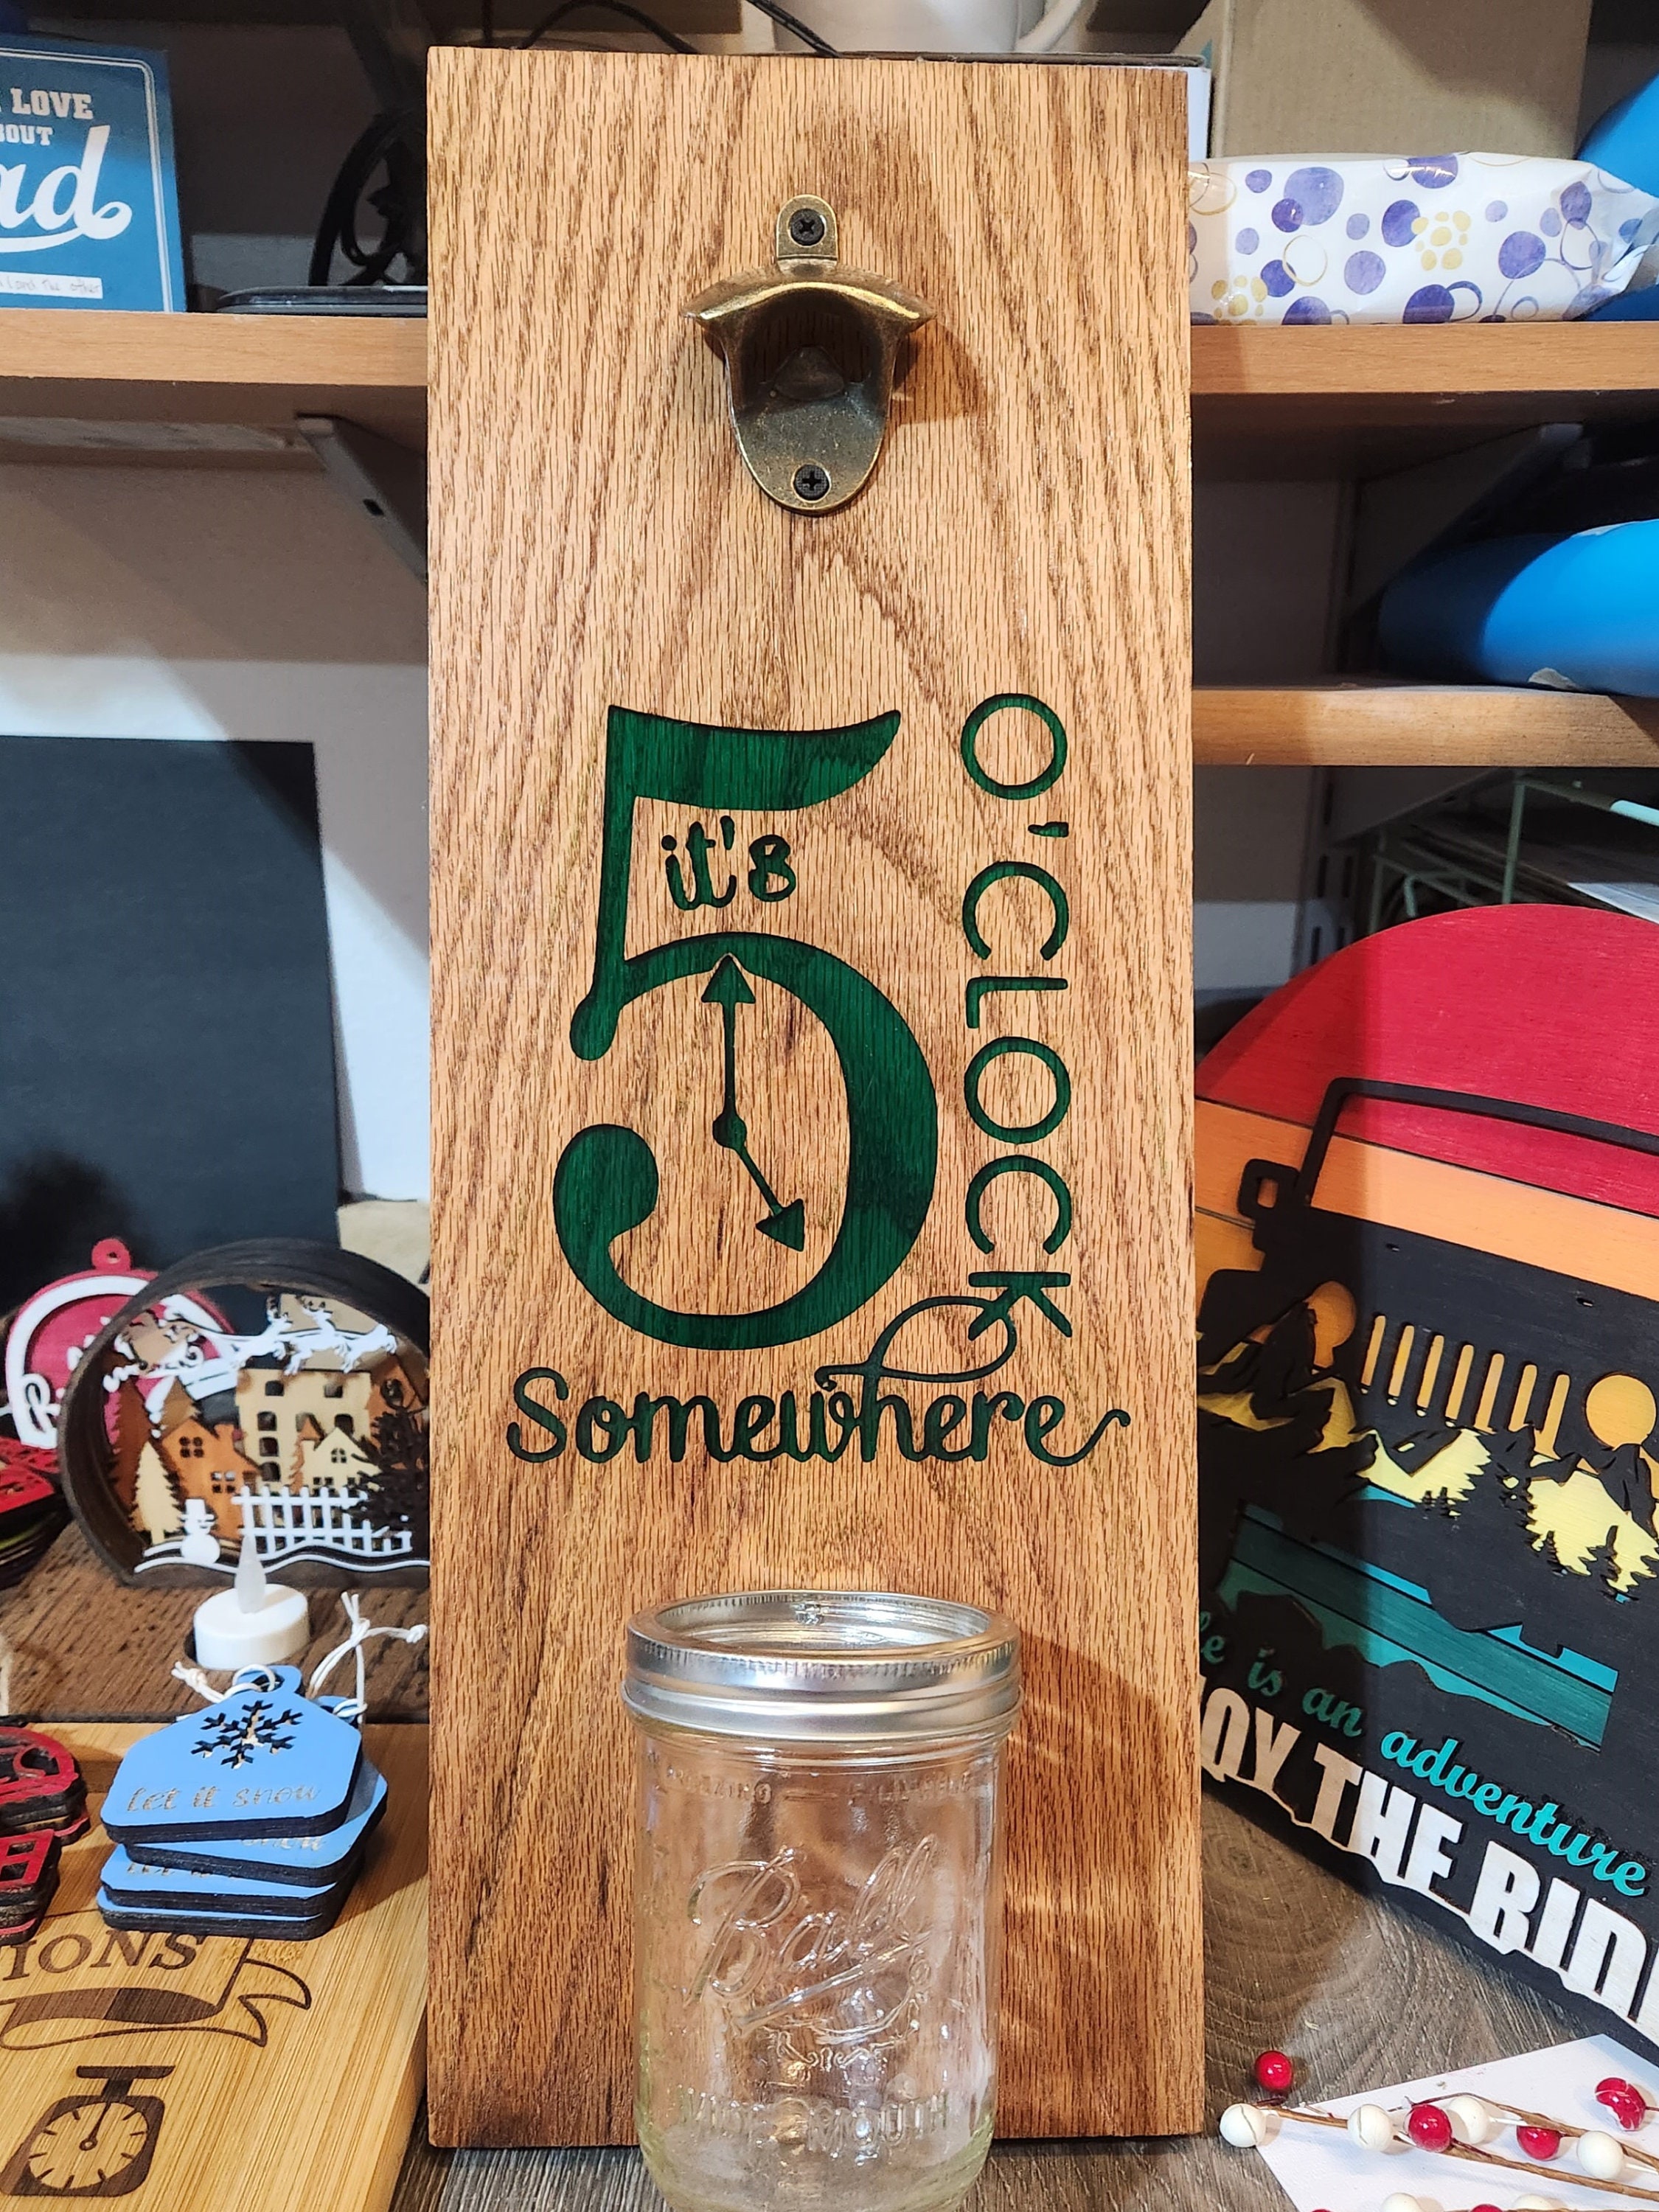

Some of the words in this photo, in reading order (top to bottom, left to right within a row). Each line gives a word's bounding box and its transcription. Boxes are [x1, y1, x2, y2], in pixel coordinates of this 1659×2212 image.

[10, 87, 94, 120] LOVE
[661, 815, 796, 911] it's
[553, 705, 939, 1351] 5
[960, 692, 1073, 1338] O'CLOCK
[506, 1349, 1131, 1467] Somewhere
[127, 1787, 180, 1812] let
[232, 1784, 321, 1807] snow
[1247, 1646, 1284, 1697] is
[1301, 1686, 1363, 1738] an
[1380, 1731, 1646, 1897] adventure
[1312, 1742, 1464, 1899] THE
[682, 1834, 938, 2007] Ball
